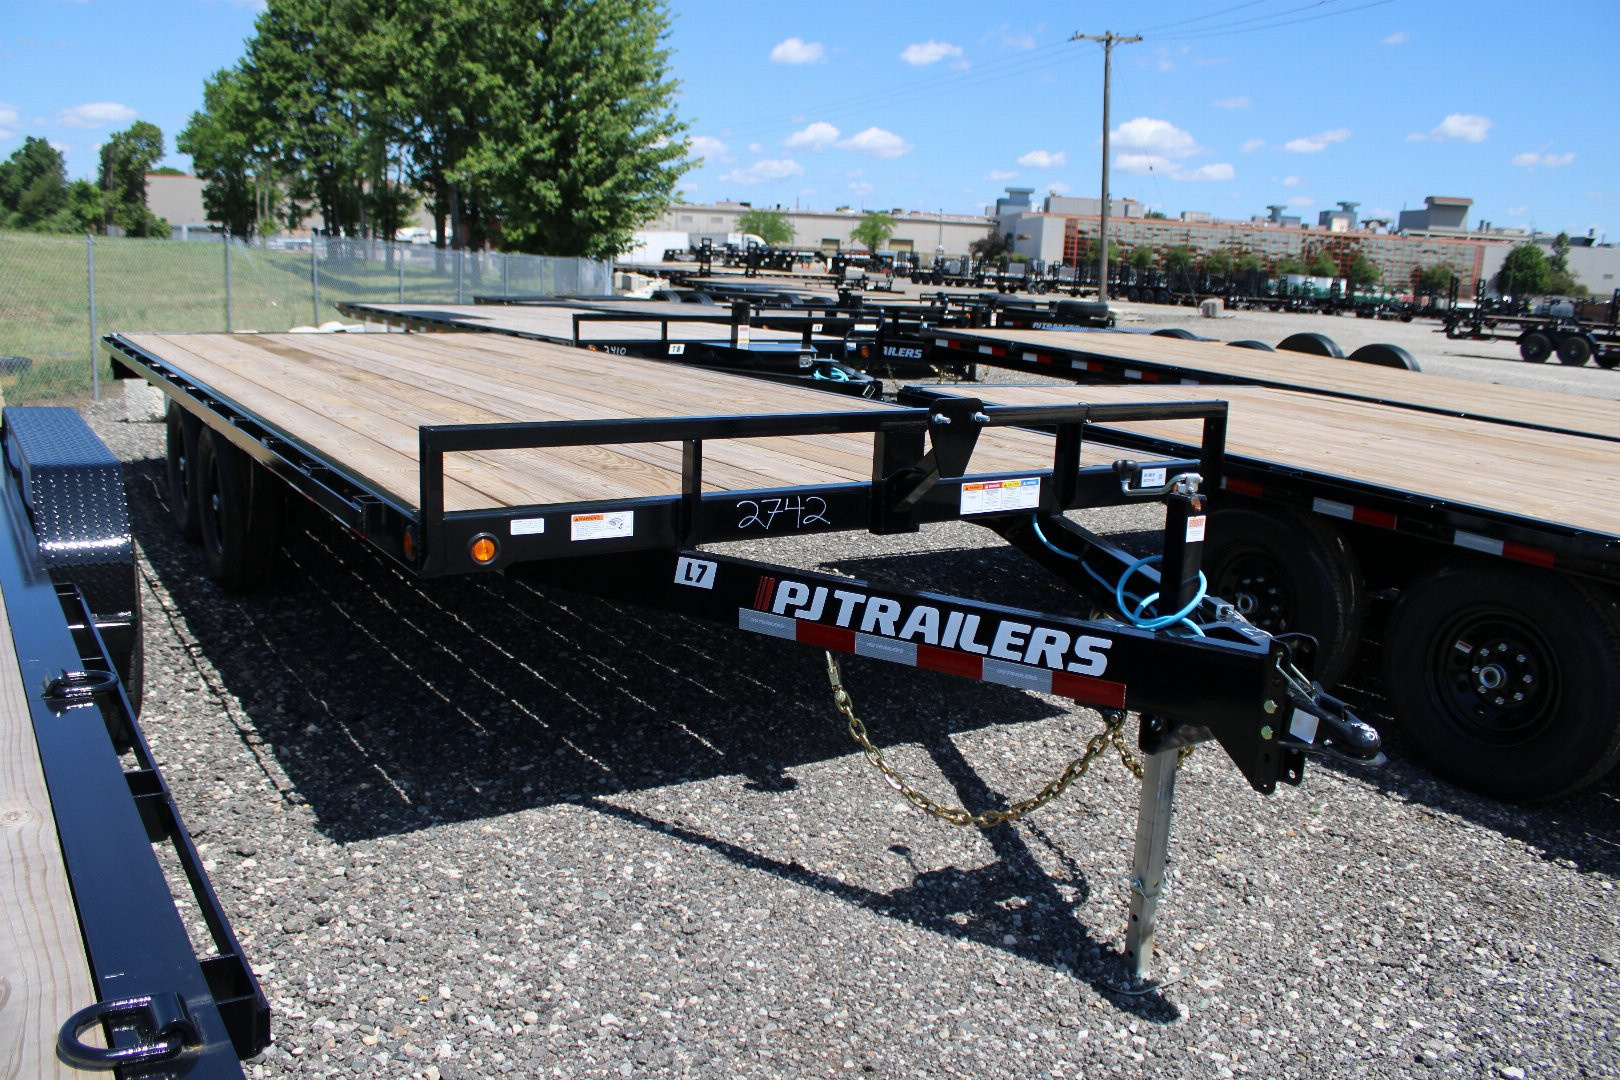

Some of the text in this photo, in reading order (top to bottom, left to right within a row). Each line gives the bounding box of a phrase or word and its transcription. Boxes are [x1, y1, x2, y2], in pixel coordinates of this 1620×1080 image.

[736, 496, 831, 530] 2742
[684, 561, 708, 584] L7
[772, 580, 1113, 677] PJ TRAILERS
